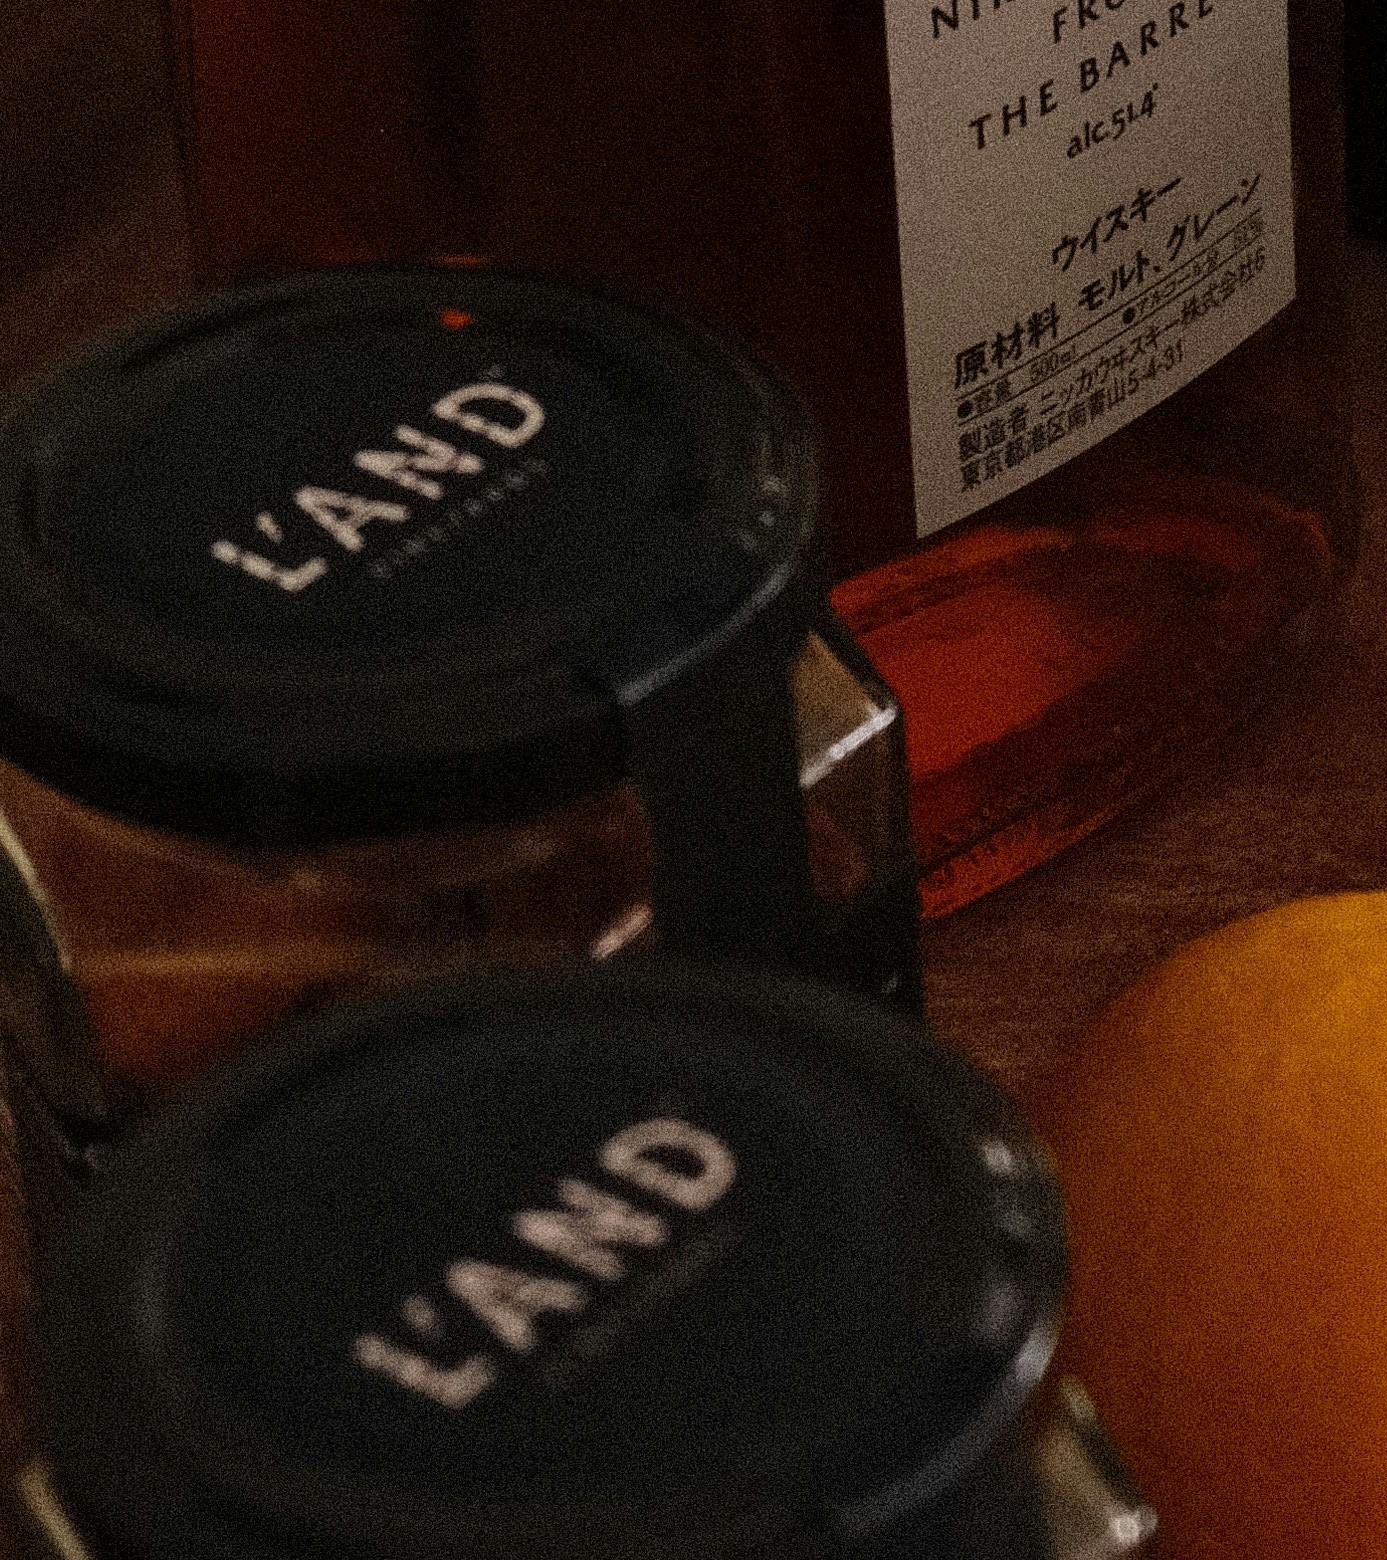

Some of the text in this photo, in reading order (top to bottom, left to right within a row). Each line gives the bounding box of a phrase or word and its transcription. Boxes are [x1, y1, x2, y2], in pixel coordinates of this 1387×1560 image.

[969, 79, 1058, 151] THE
[1051, 177, 1183, 272] ウイスキー
[954, 302, 1061, 390] 原材料
